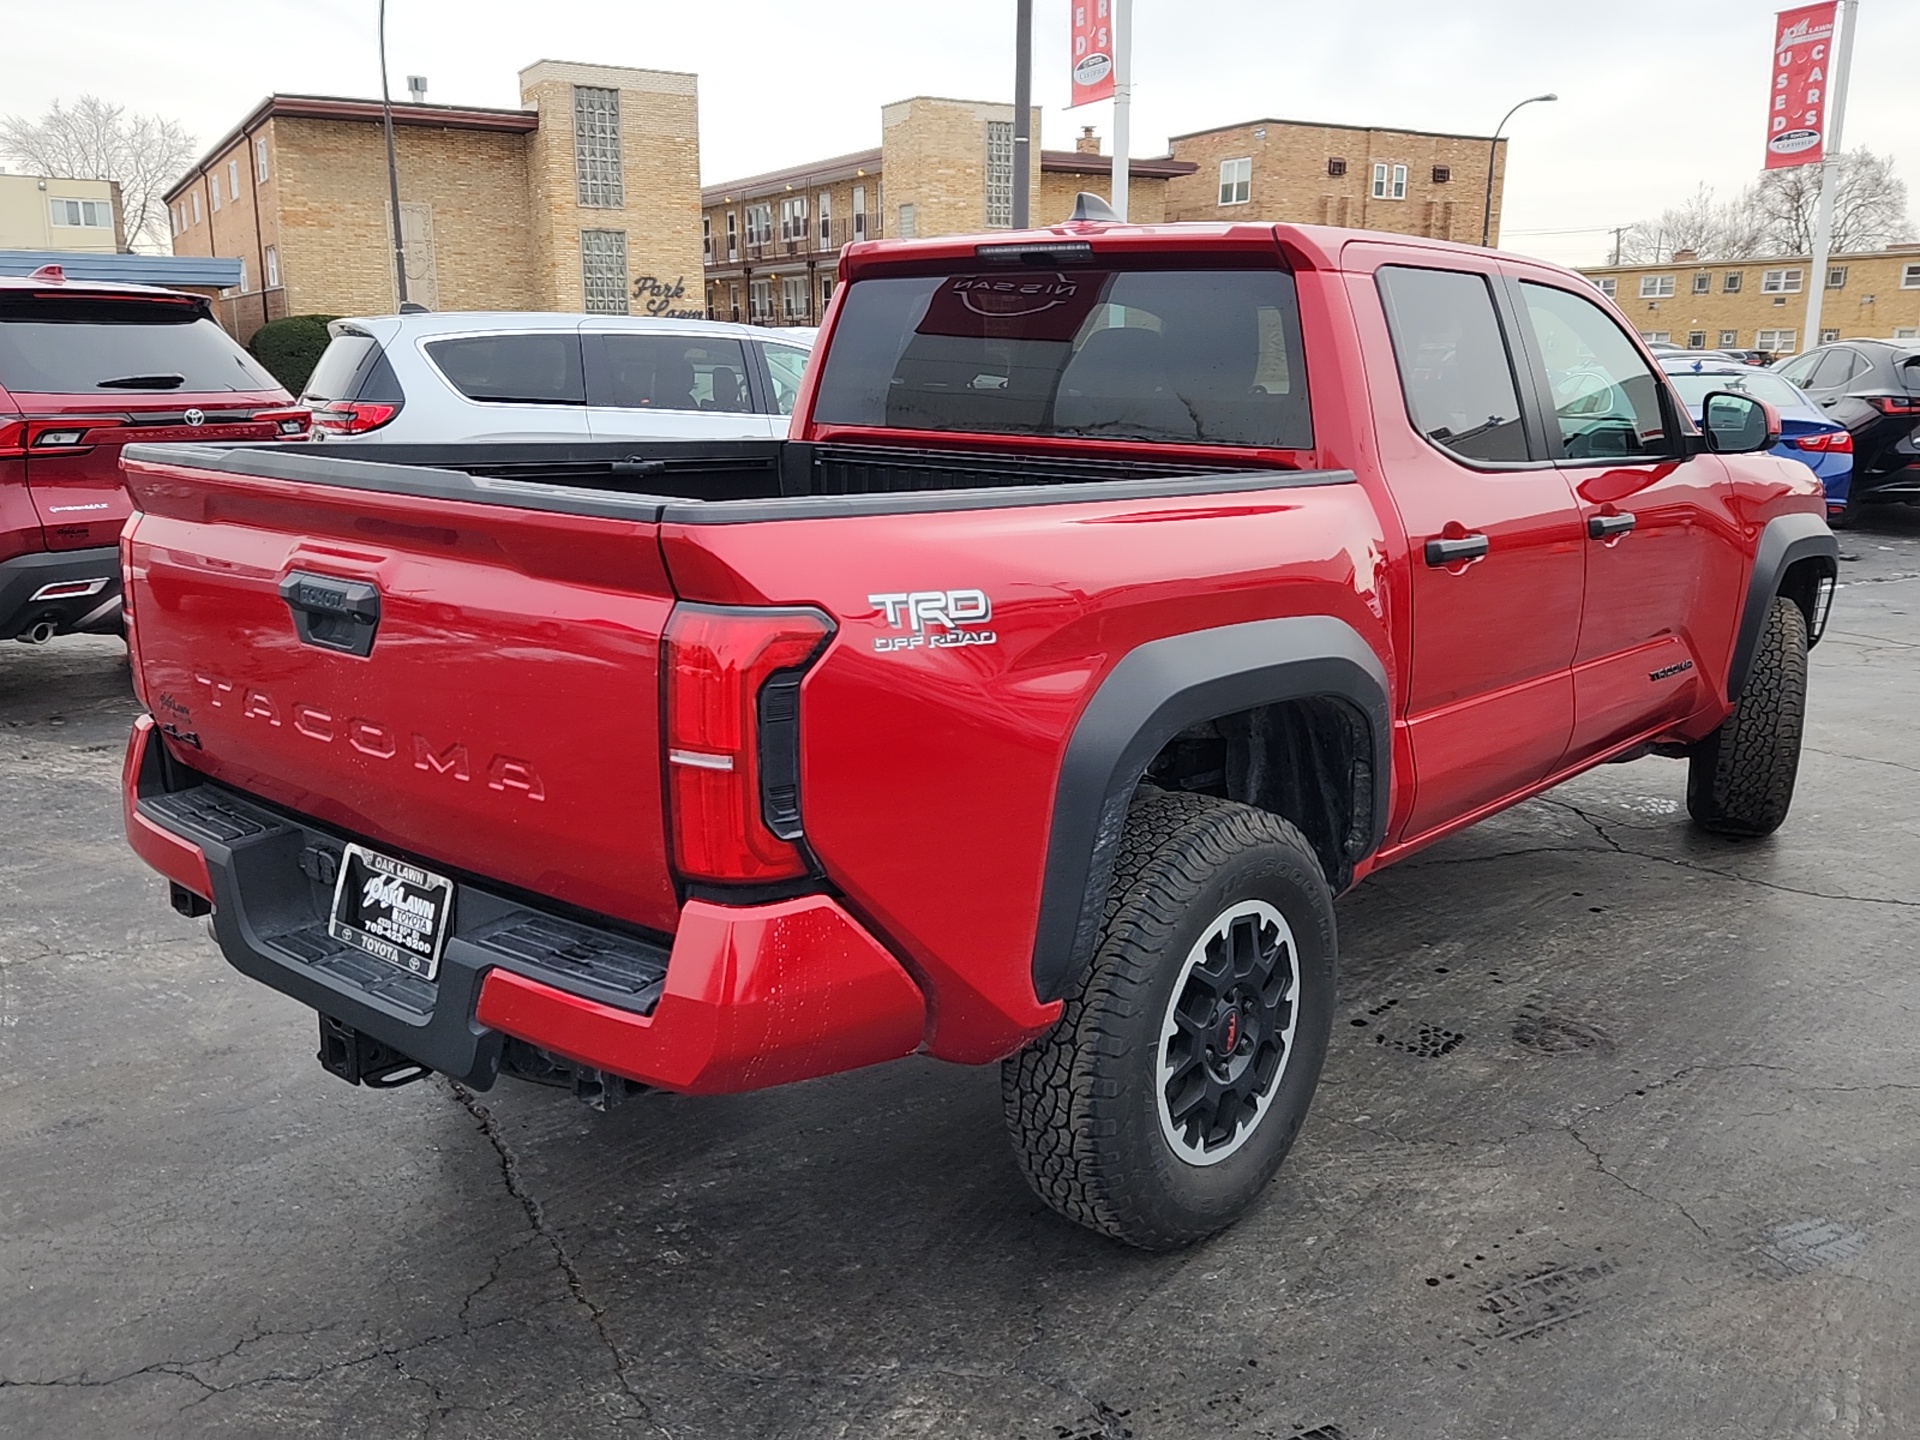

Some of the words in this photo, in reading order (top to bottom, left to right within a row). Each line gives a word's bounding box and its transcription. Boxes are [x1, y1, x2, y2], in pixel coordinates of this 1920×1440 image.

[633, 275, 685, 299] Park
[868, 589, 991, 634] TRD
[874, 634, 924, 652] OFF
[927, 628, 997, 649] ROAD
[194, 672, 545, 801] TACOMA
[374, 856, 395, 874] OAK
[396, 864, 425, 884] LAWN
[396, 910, 428, 931] TOYOTA
[361, 935, 400, 962] TOYOTA
[364, 920, 432, 954] 708-423-5200
